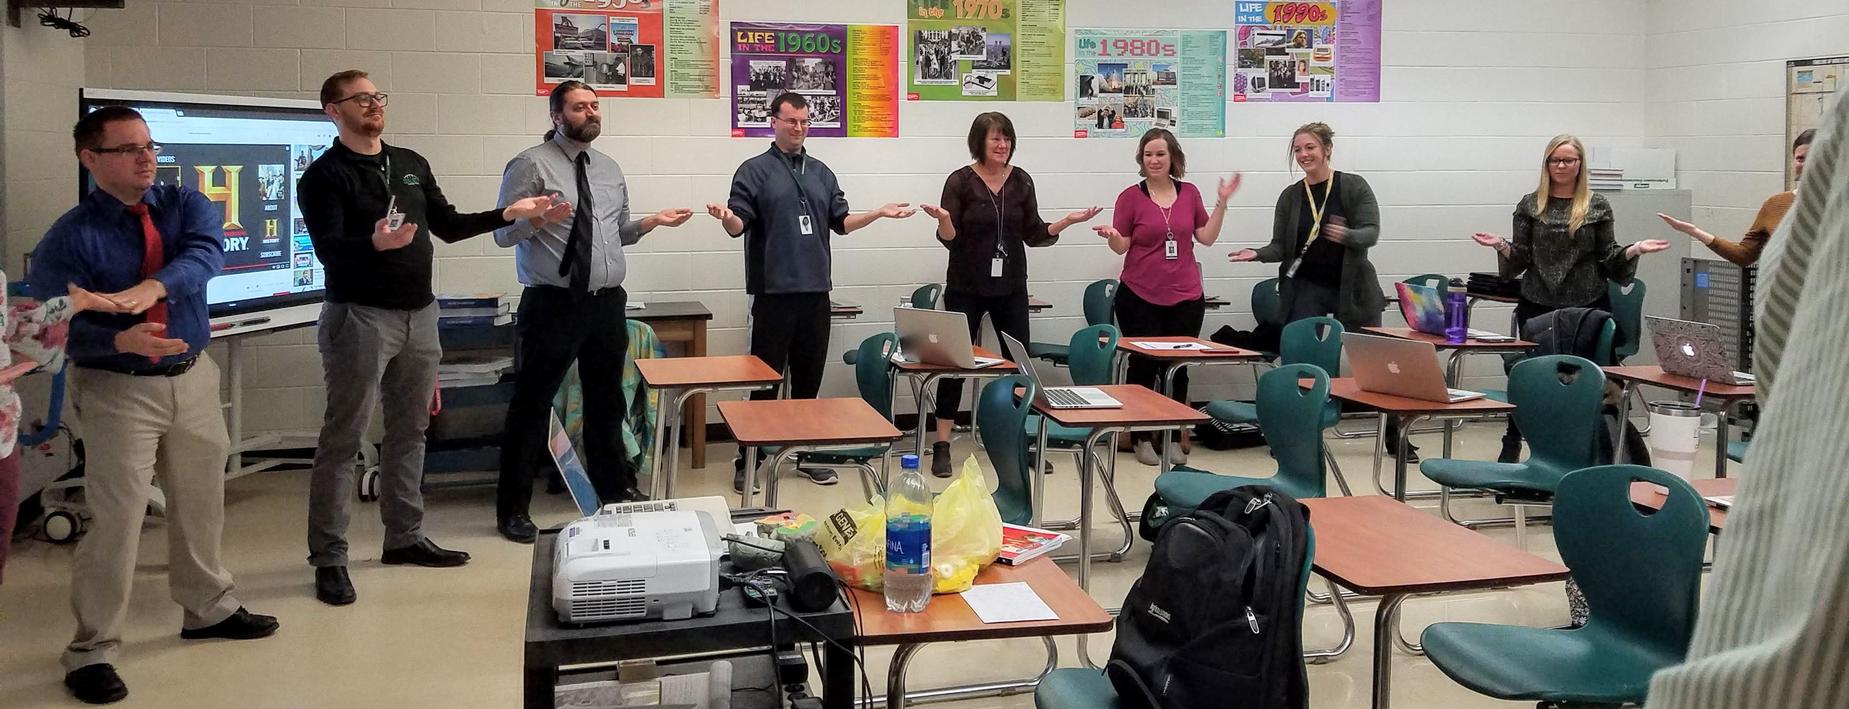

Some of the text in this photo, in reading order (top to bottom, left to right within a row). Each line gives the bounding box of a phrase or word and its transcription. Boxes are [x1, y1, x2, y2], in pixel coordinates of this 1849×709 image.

[953, 0, 1011, 19] 1970s
[1240, 3, 1263, 12] LIFE
[1272, 2, 1328, 23] 1990s
[737, 31, 775, 43] LIFE
[778, 32, 842, 53] 1960s
[1079, 39, 1096, 49] Life
[754, 44, 775, 52] THE
[1098, 39, 1177, 56] 1980s
[193, 165, 244, 230] H
